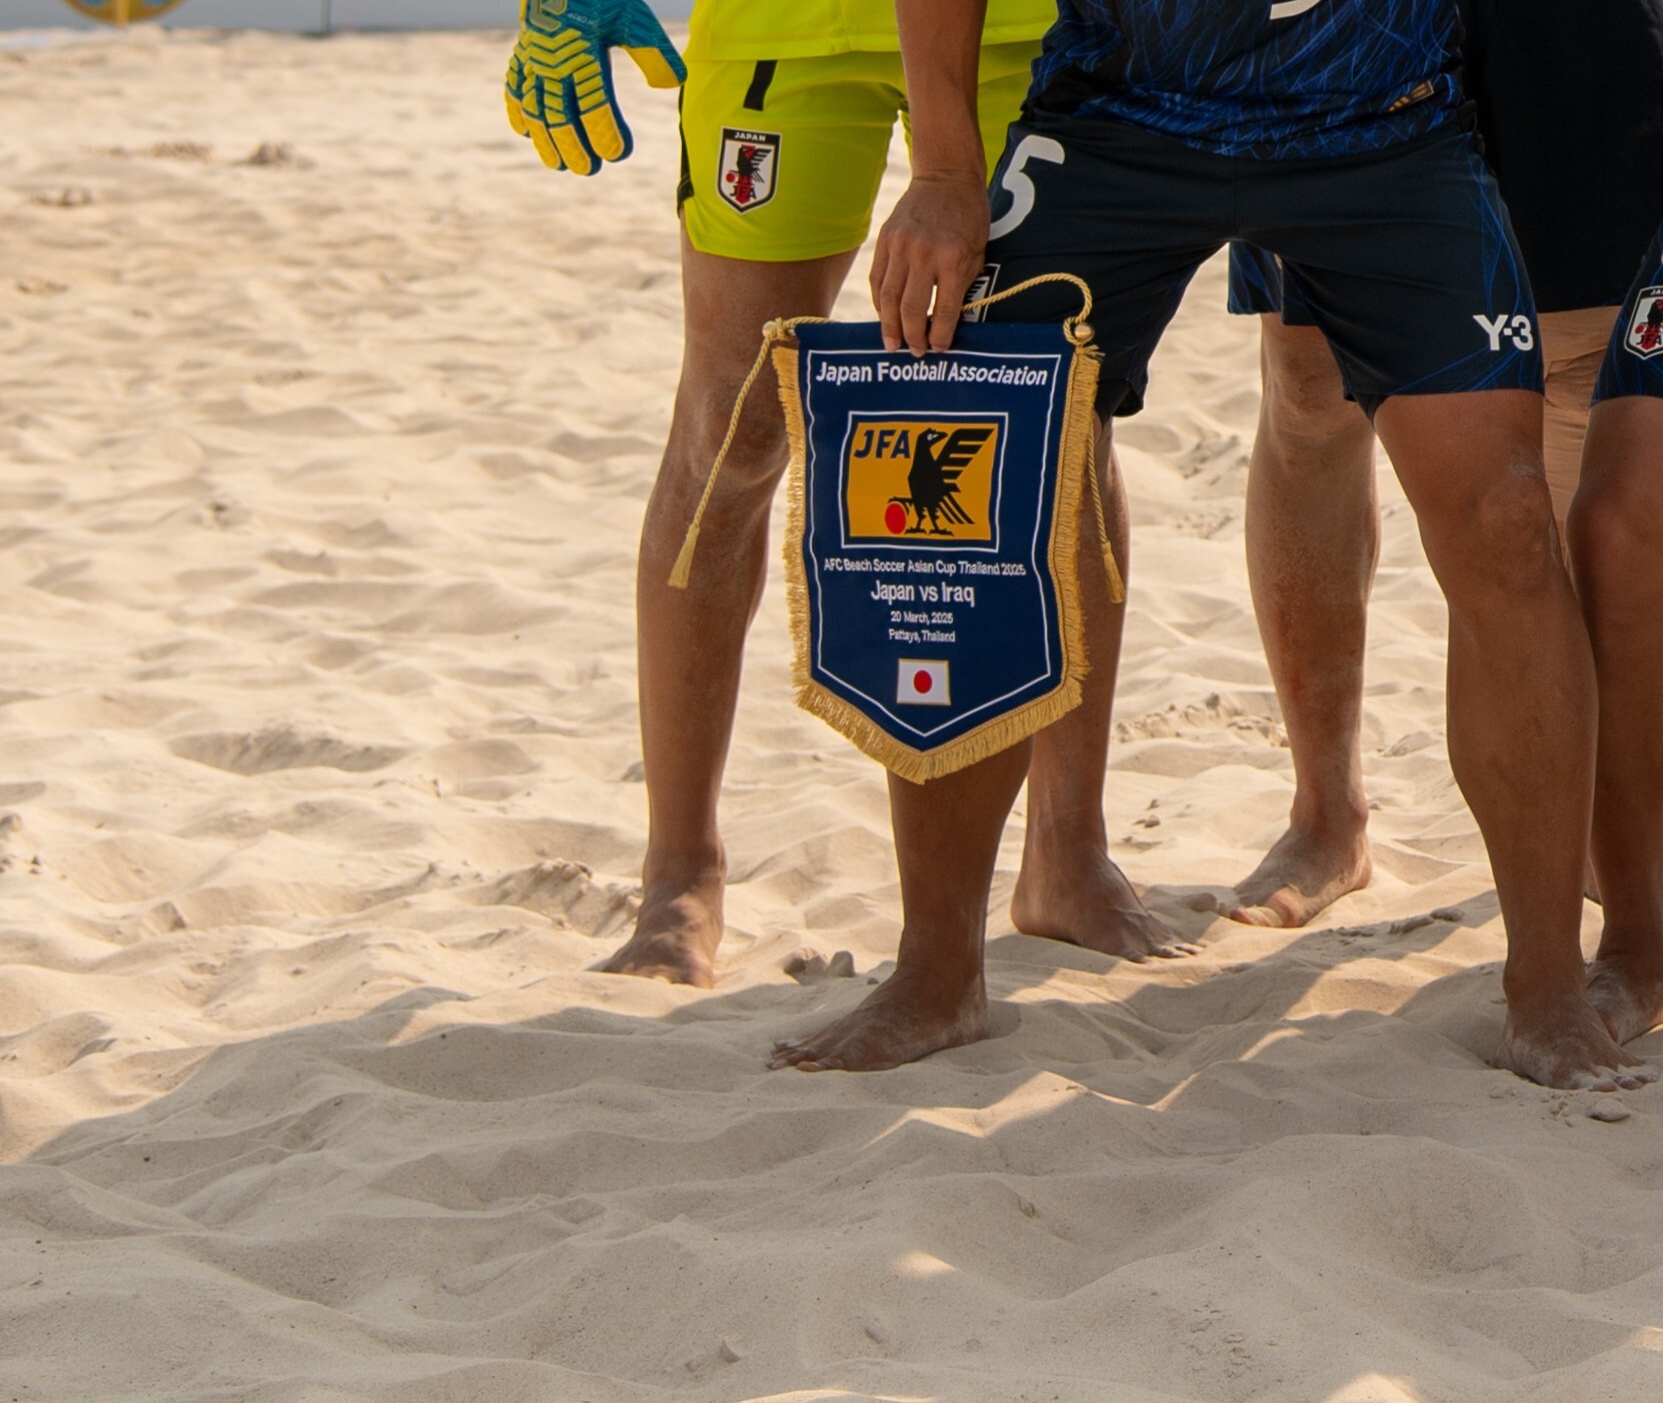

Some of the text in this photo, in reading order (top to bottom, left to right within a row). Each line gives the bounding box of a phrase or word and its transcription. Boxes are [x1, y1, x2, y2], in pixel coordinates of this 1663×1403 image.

[734, 132, 766, 142] JAPAN
[989, 134, 1065, 242] 5
[1473, 314, 1533, 351] Y-3
[816, 361, 1047, 386] Japan Football Association
[853, 429, 910, 459] JFA
[824, 558, 1027, 576] AFC Beach Soccer Asian Cup Thailand 2025
[870, 579, 976, 608] Japan vs Iraq
[890, 610, 901, 622] 20
[903, 611, 930, 626] March,
[888, 628, 956, 643] Pattaya, Thailand
